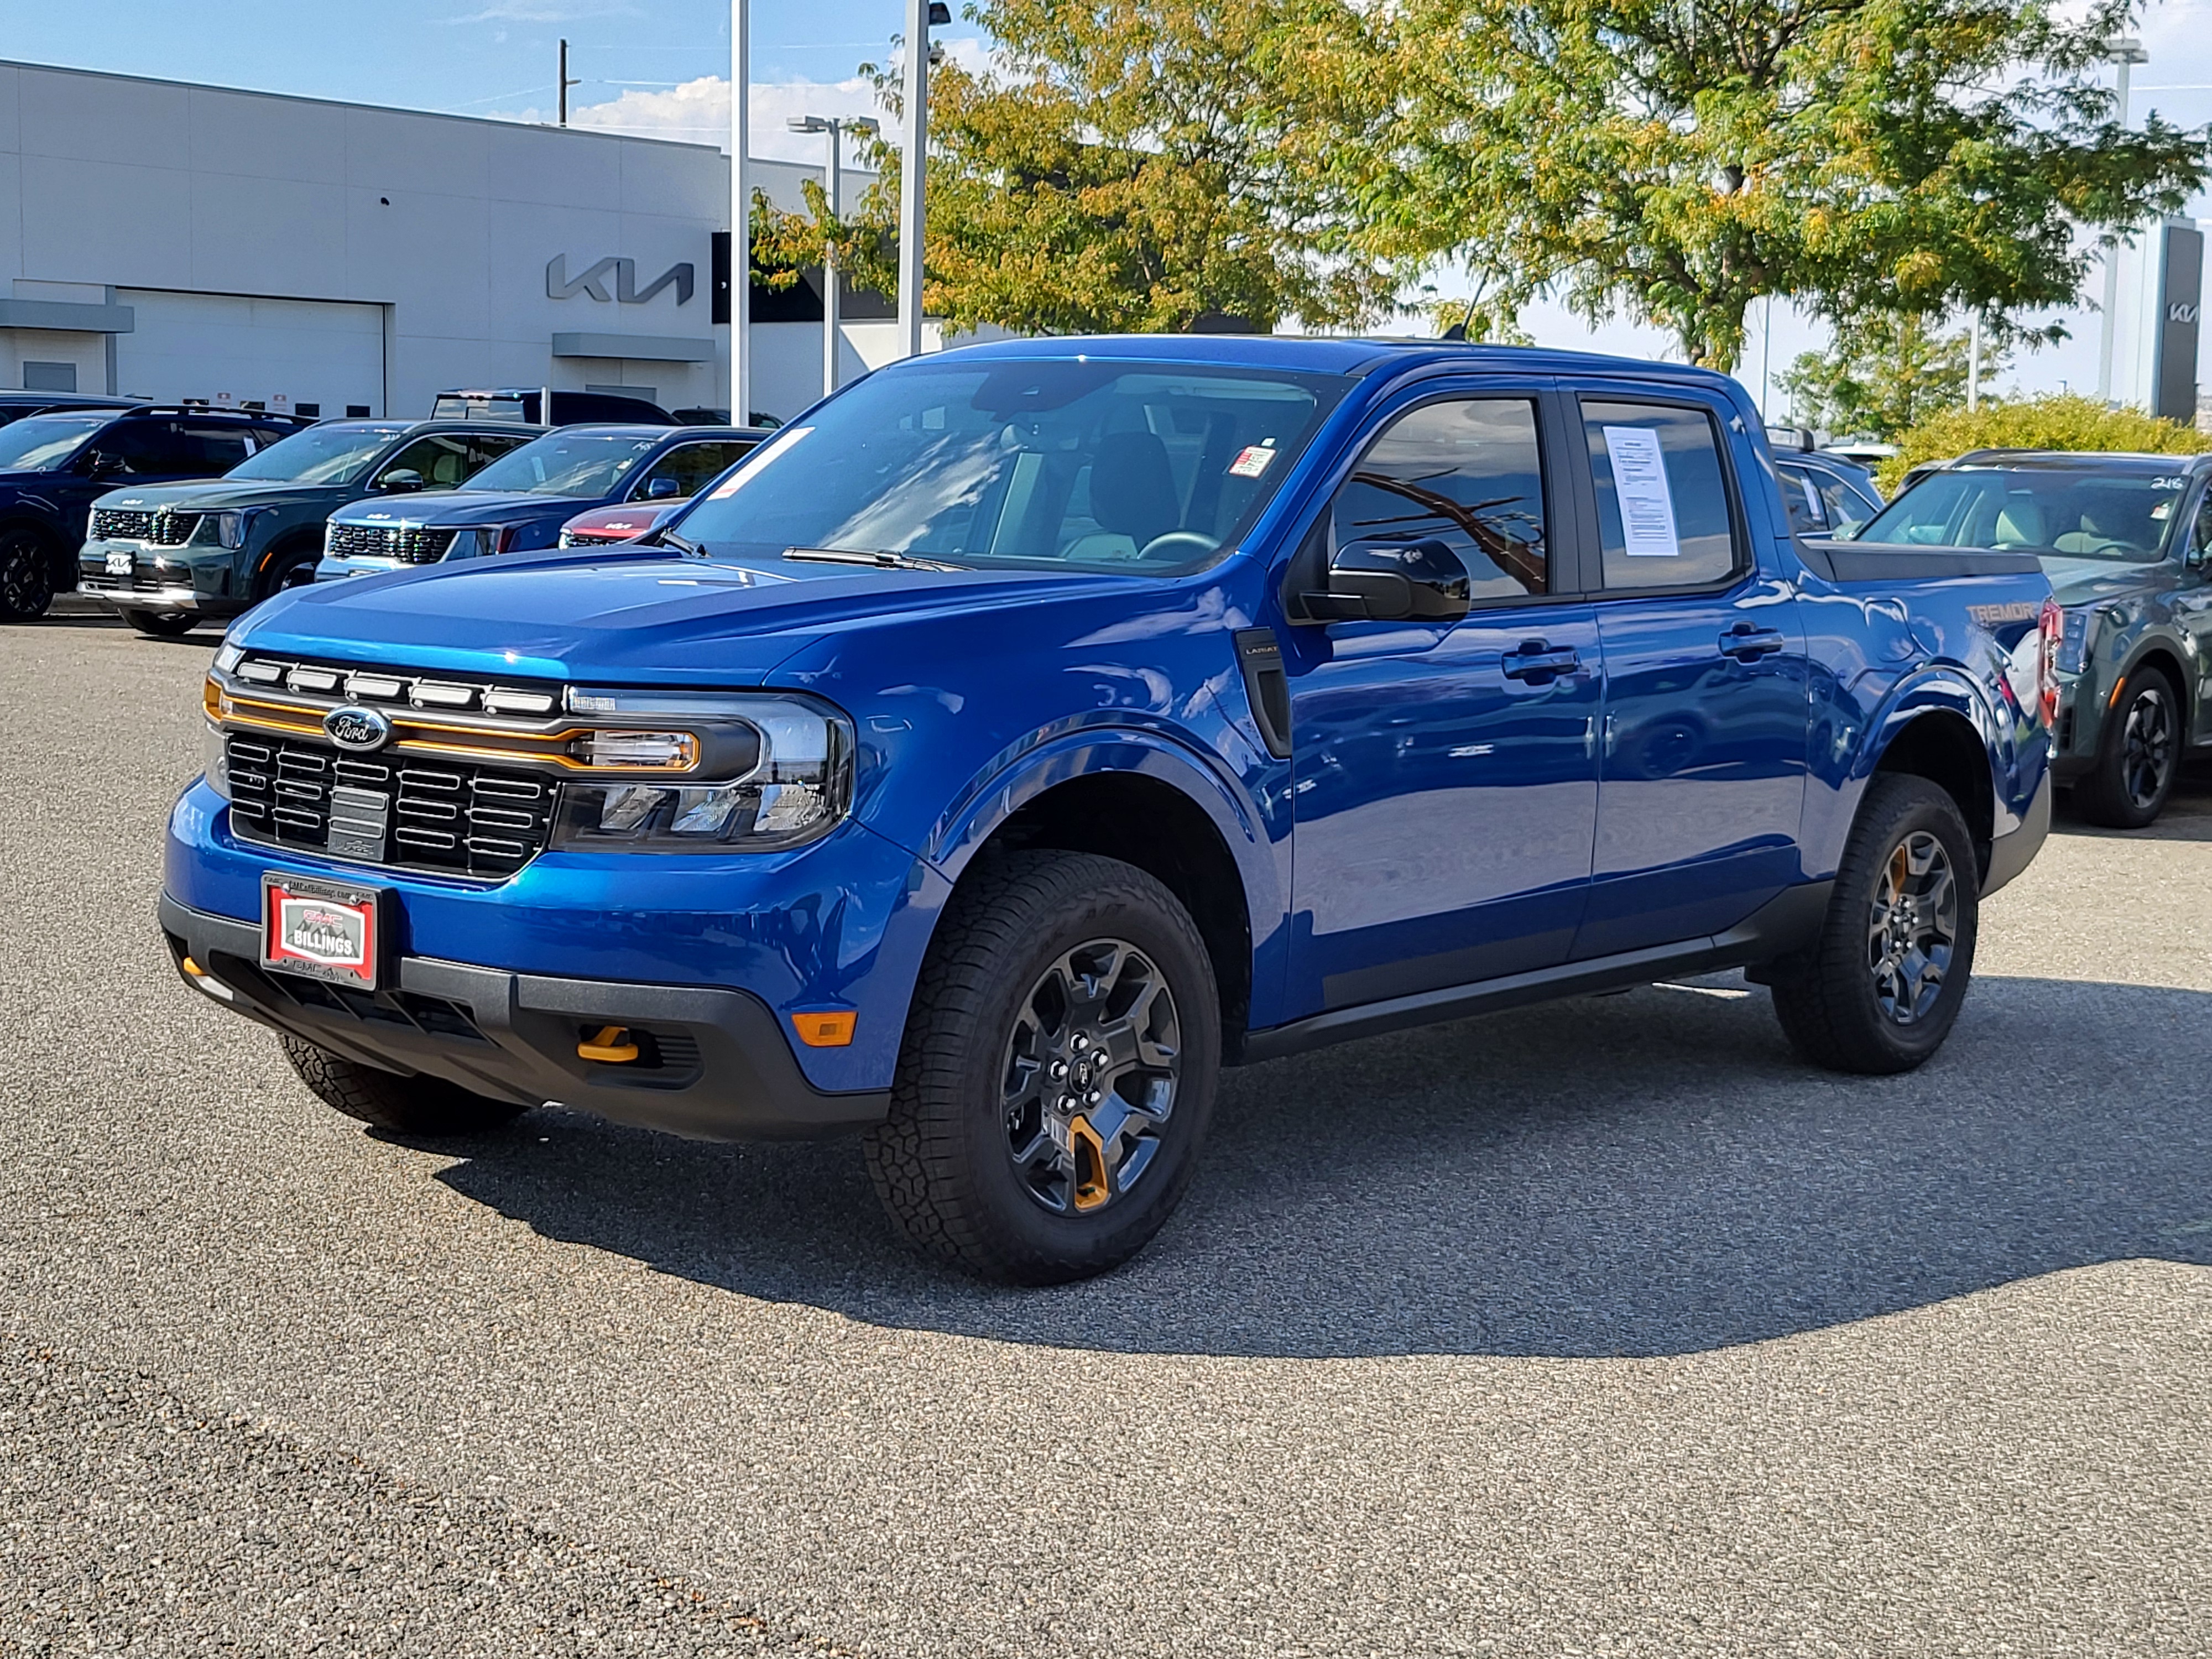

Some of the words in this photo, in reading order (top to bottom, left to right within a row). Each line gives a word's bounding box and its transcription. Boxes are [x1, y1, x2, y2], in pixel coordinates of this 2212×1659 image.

[546, 253, 693, 306] KIA
[2169, 302, 2198, 322] KIA
[1965, 603, 2036, 622] TREMOR
[335, 716, 370, 741] Ford
[294, 930, 353, 955] BILLINGS
